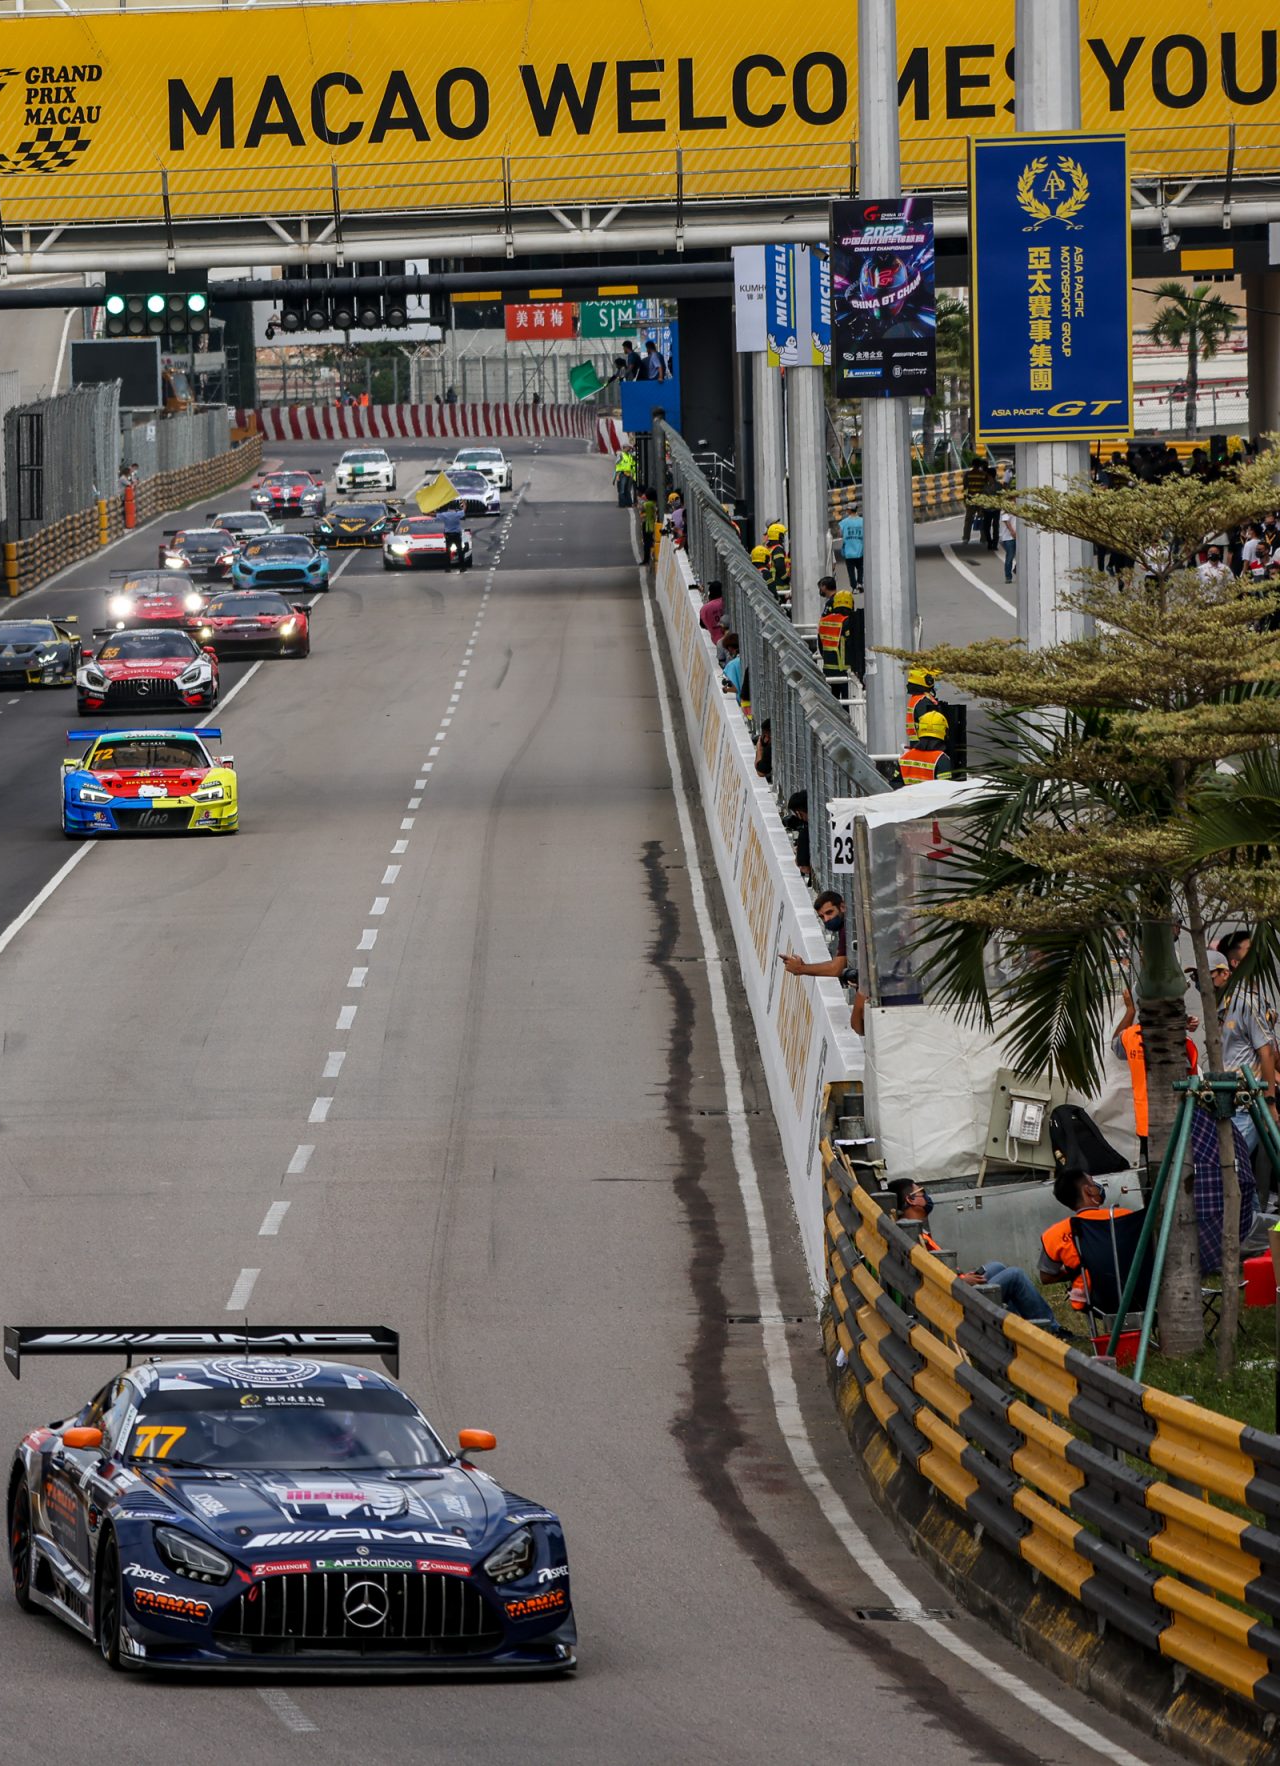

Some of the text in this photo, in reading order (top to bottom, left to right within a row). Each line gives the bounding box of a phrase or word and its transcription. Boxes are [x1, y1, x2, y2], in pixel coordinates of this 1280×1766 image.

[24, 65, 103, 84] GRAND
[24, 87, 77, 104] PRIX
[167, 30, 1277, 151] MACAO WELCOME YOU
[23, 105, 102, 126] MACAU
[864, 225, 905, 238] 2022
[739, 283, 767, 293] KUMH
[774, 243, 788, 328] MICHELI
[1074, 246, 1085, 318] ASIA PACIFIC
[1060, 246, 1072, 358] MOTORSPORT GROUP
[516, 308, 564, 329] 美高梅
[599, 308, 633, 333] SJM
[1027, 246, 1053, 391] 亞太賽事集團
[990, 399, 1123, 418] ASIA PACIFIC GT
[94, 748, 114, 762] 72
[833, 836, 855, 865] 23
[132, 1425, 187, 1459] 77
[318, 1527, 473, 1550] AMG
[265, 1563, 309, 1574] CHALLENGER
[430, 1563, 470, 1574] CHALLENGER
[134, 1588, 209, 1619] TARMAC
[507, 1589, 566, 1618] TARMAC
